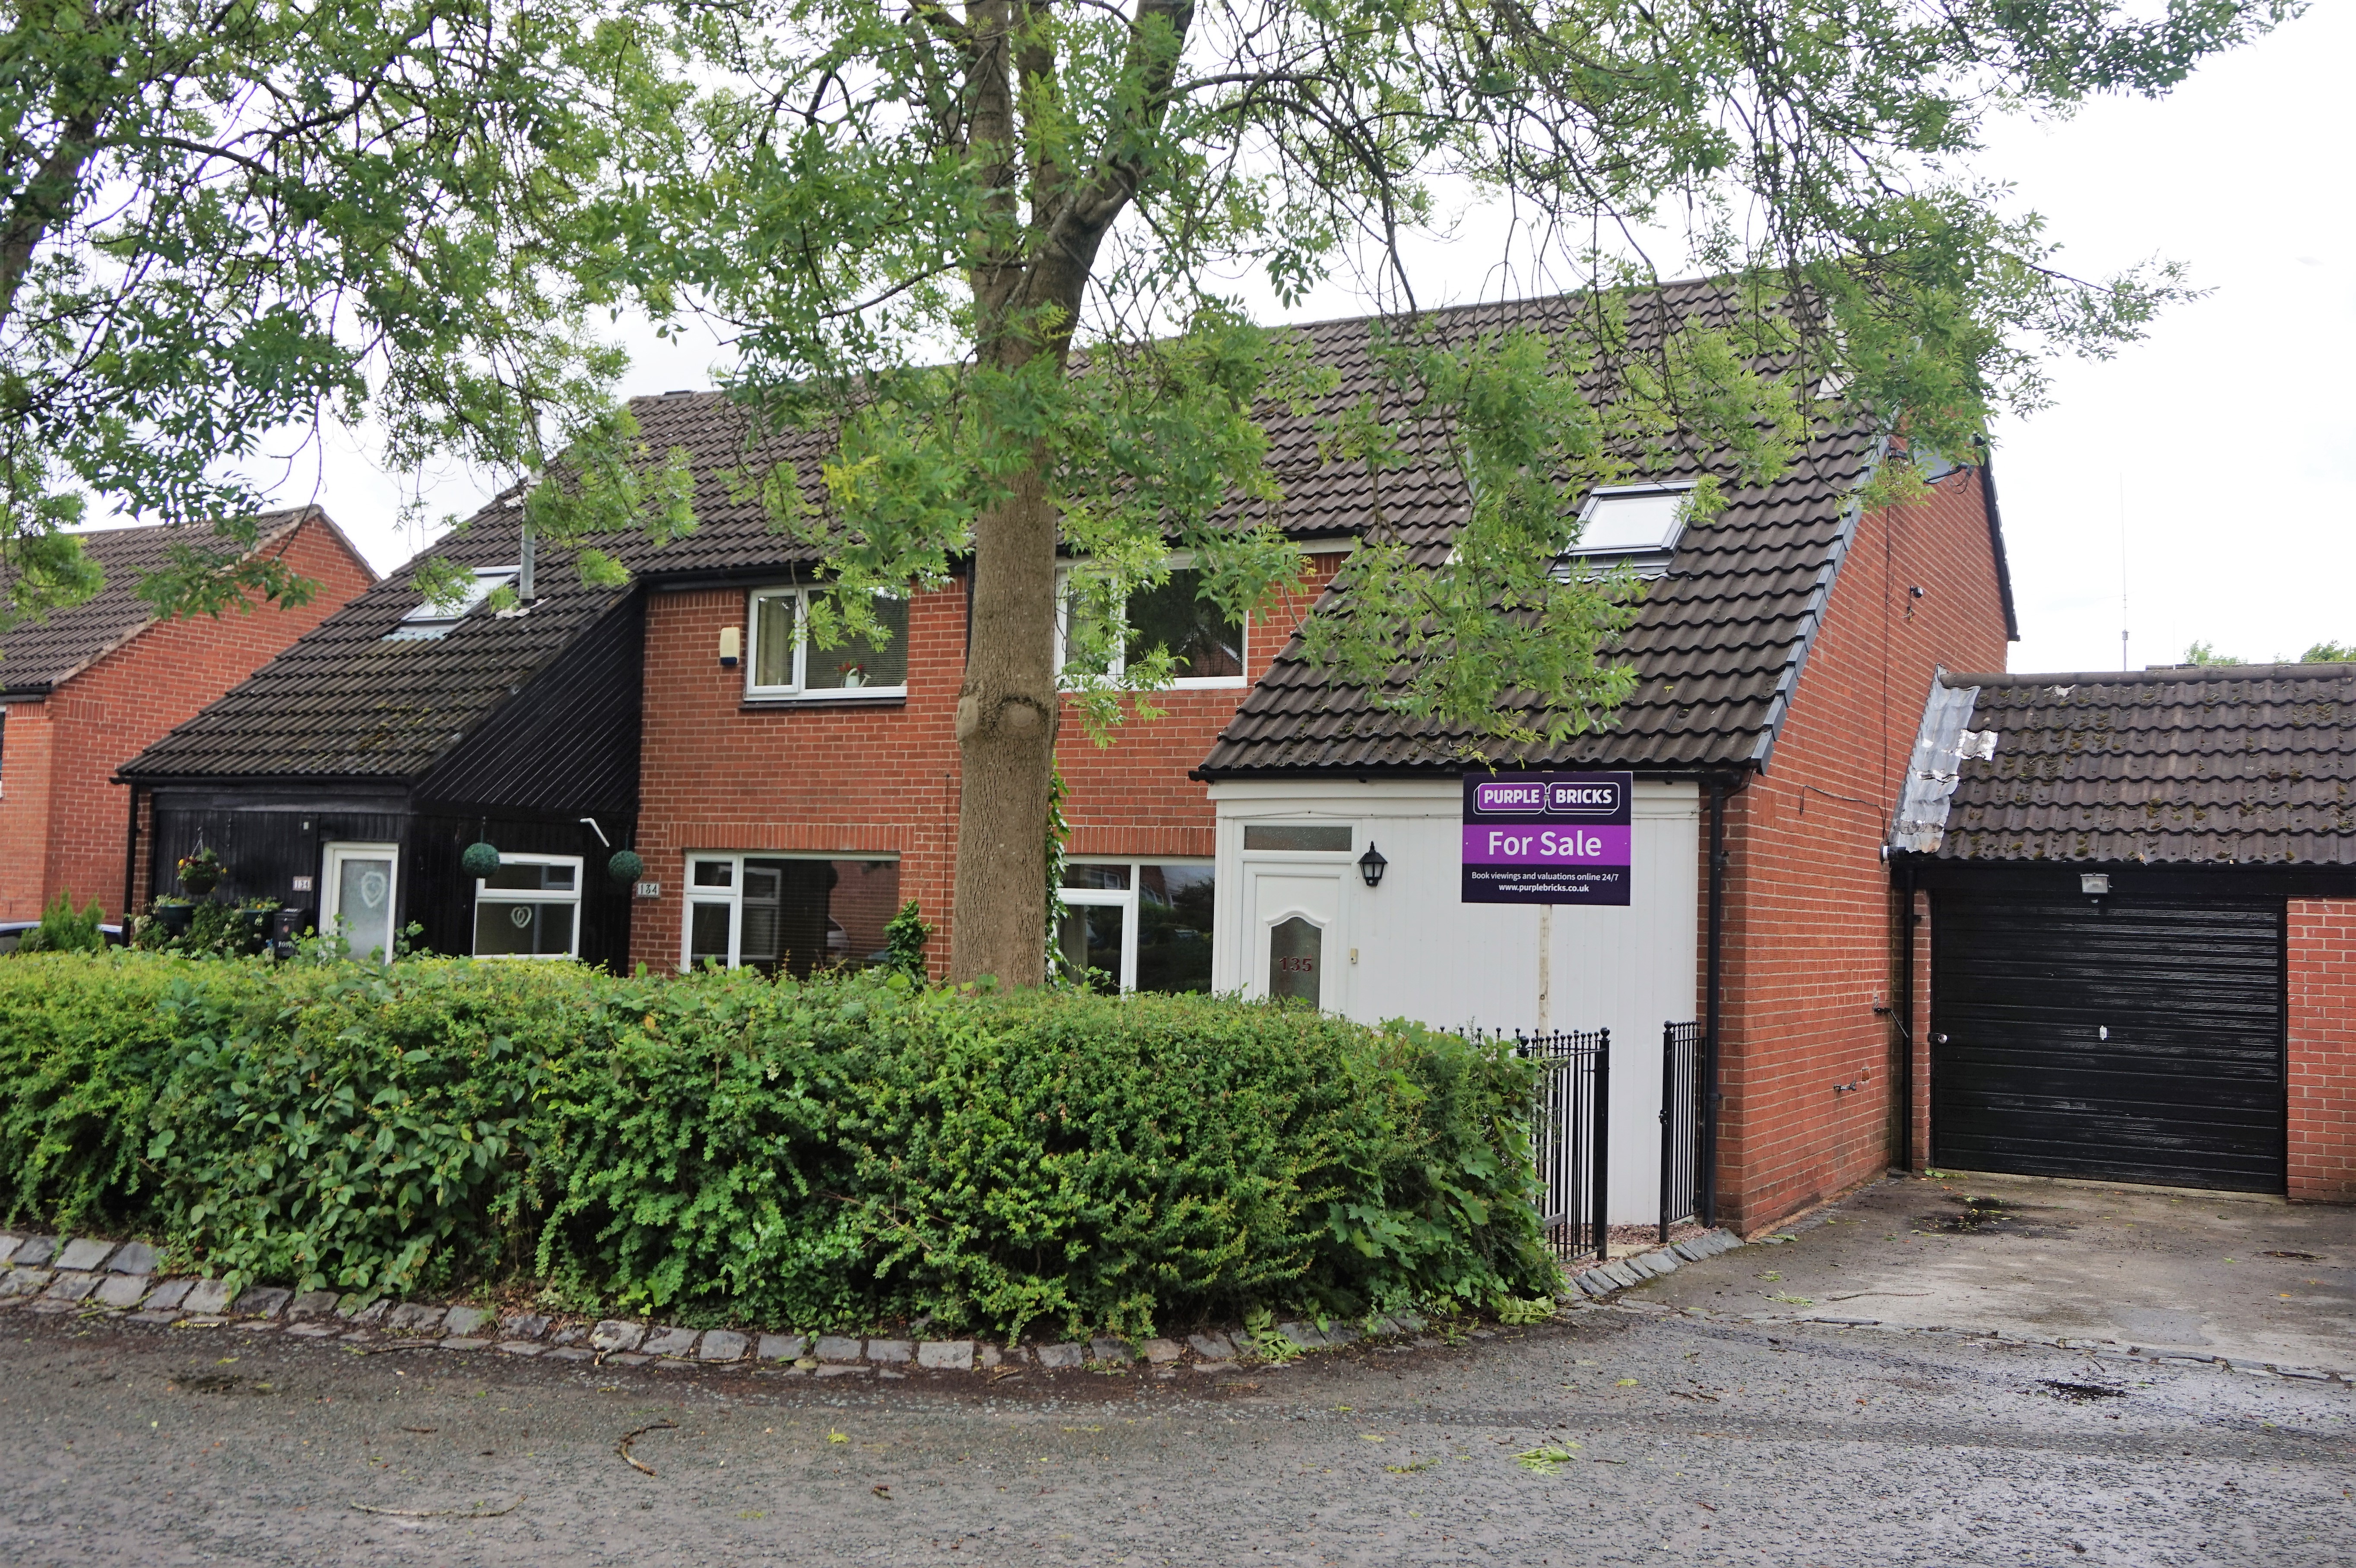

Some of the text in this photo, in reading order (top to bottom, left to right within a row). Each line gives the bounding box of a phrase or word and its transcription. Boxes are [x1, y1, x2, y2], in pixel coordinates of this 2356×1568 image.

[1484, 789, 1612, 804] PURPLE BRICKS
[1489, 830, 1602, 856] For Sale
[1472, 871, 1490, 879] Book
[1491, 872, 1521, 882] viewings
[1537, 872, 1576, 880] valuations
[1602, 873, 1619, 882] 24/7
[641, 884, 657, 895] 134
[1498, 883, 1589, 893] www.purplebricks.co.uk
[1279, 956, 1312, 972] 135
